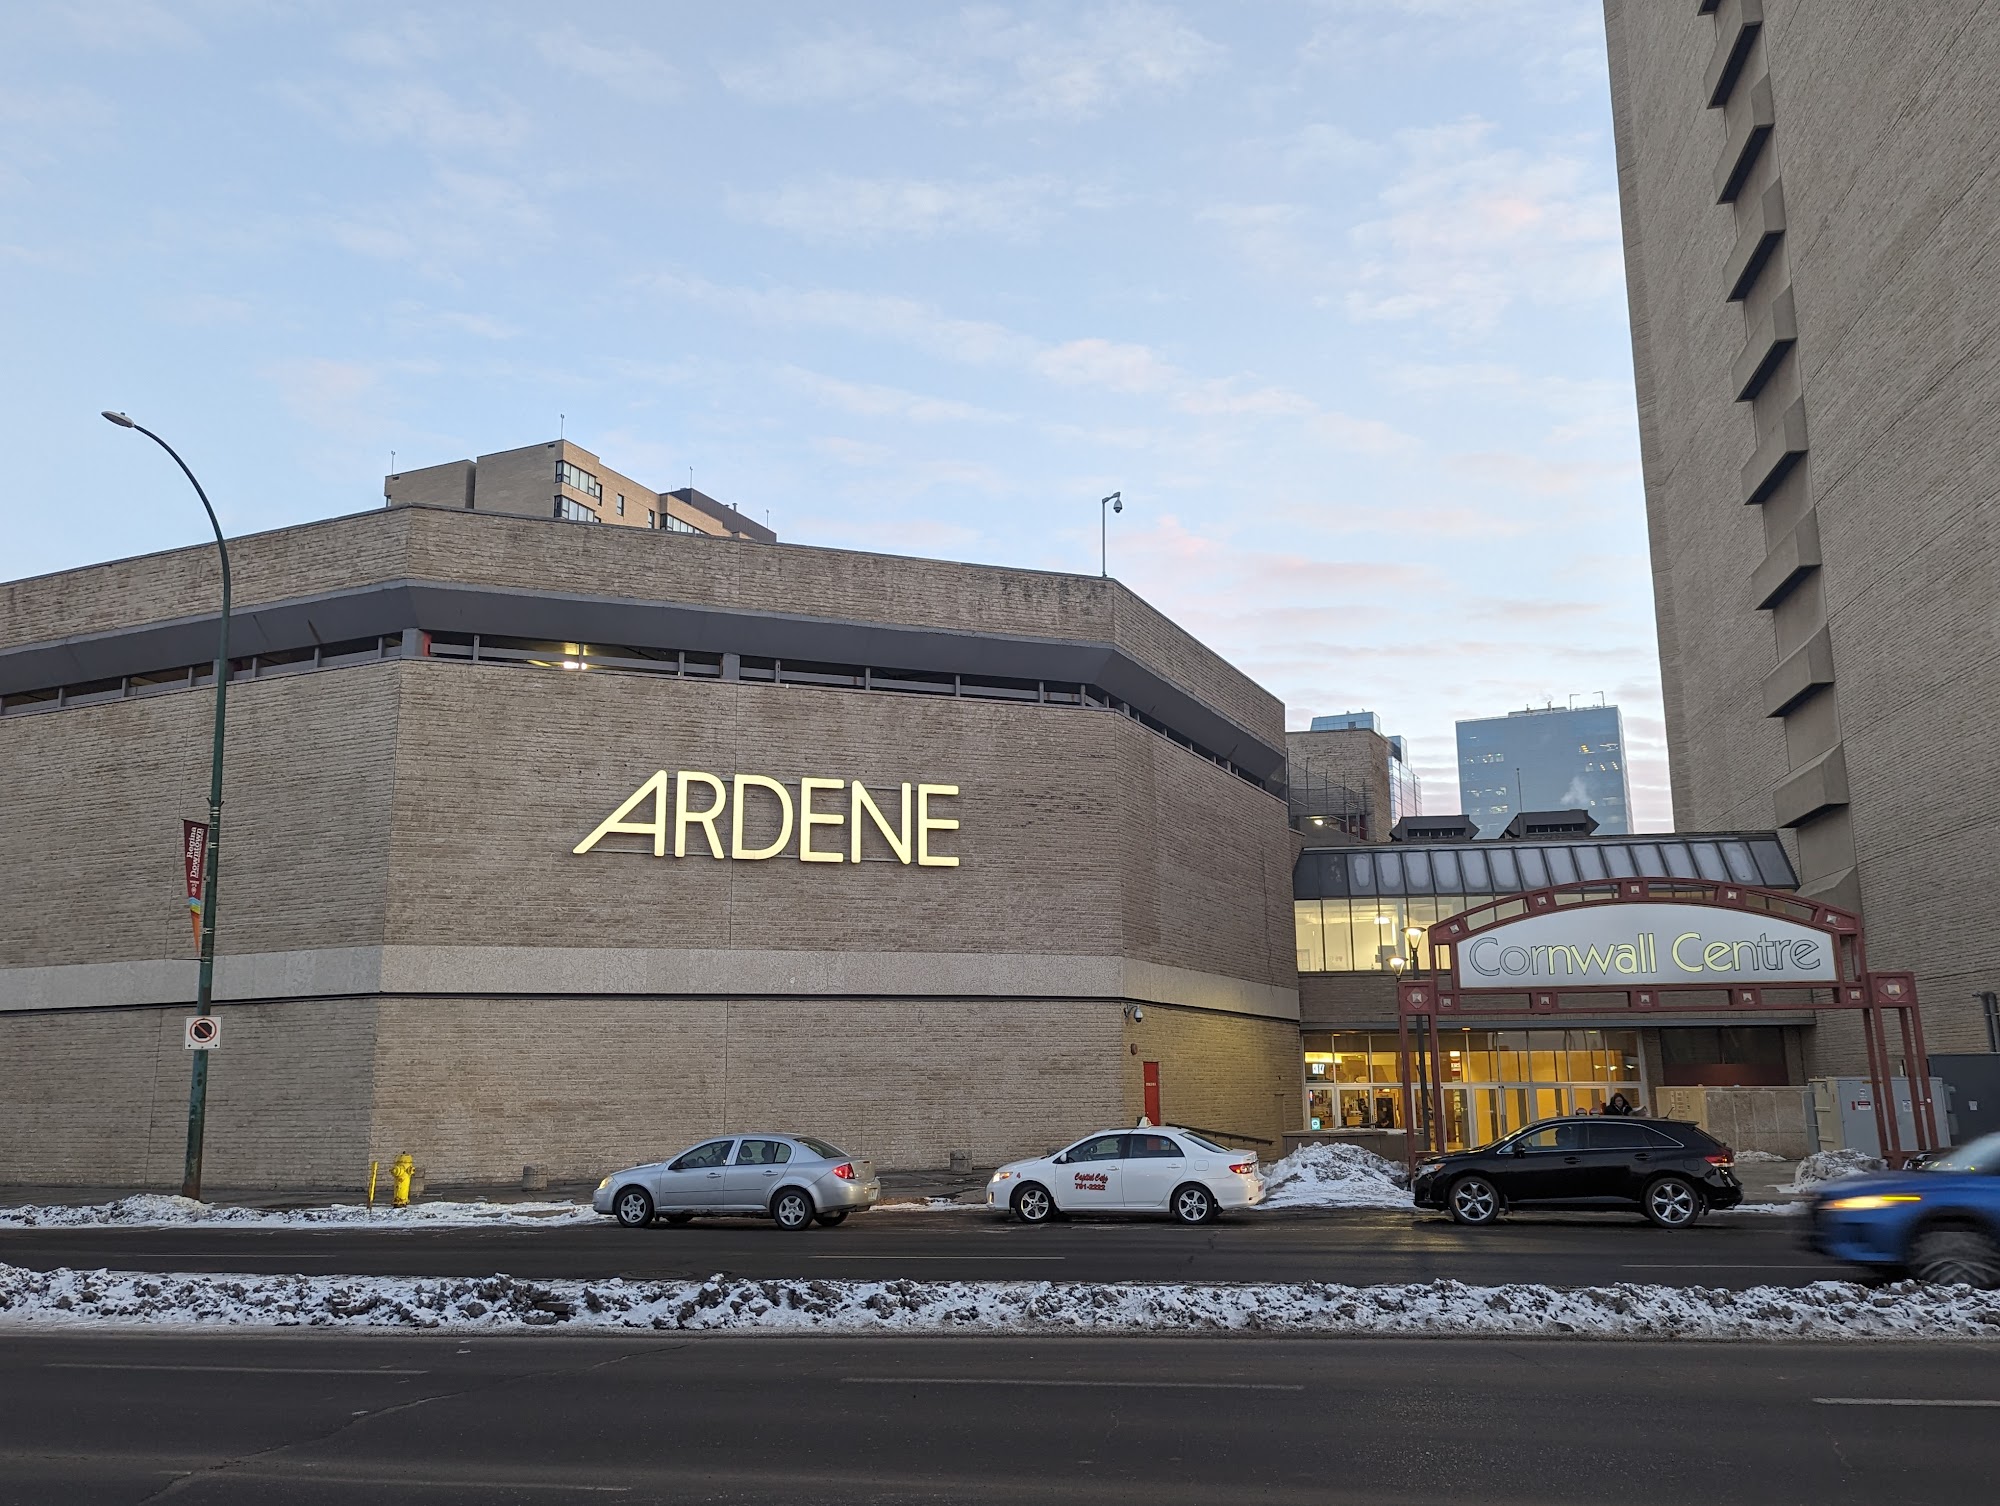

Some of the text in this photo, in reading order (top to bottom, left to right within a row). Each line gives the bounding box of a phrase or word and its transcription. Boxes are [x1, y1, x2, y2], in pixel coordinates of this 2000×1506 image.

[572, 770, 960, 866] ARDENE
[187, 827, 197, 858] Regina
[190, 828, 203, 878] Downtown
[1469, 932, 1821, 976] Cornwall Centre
